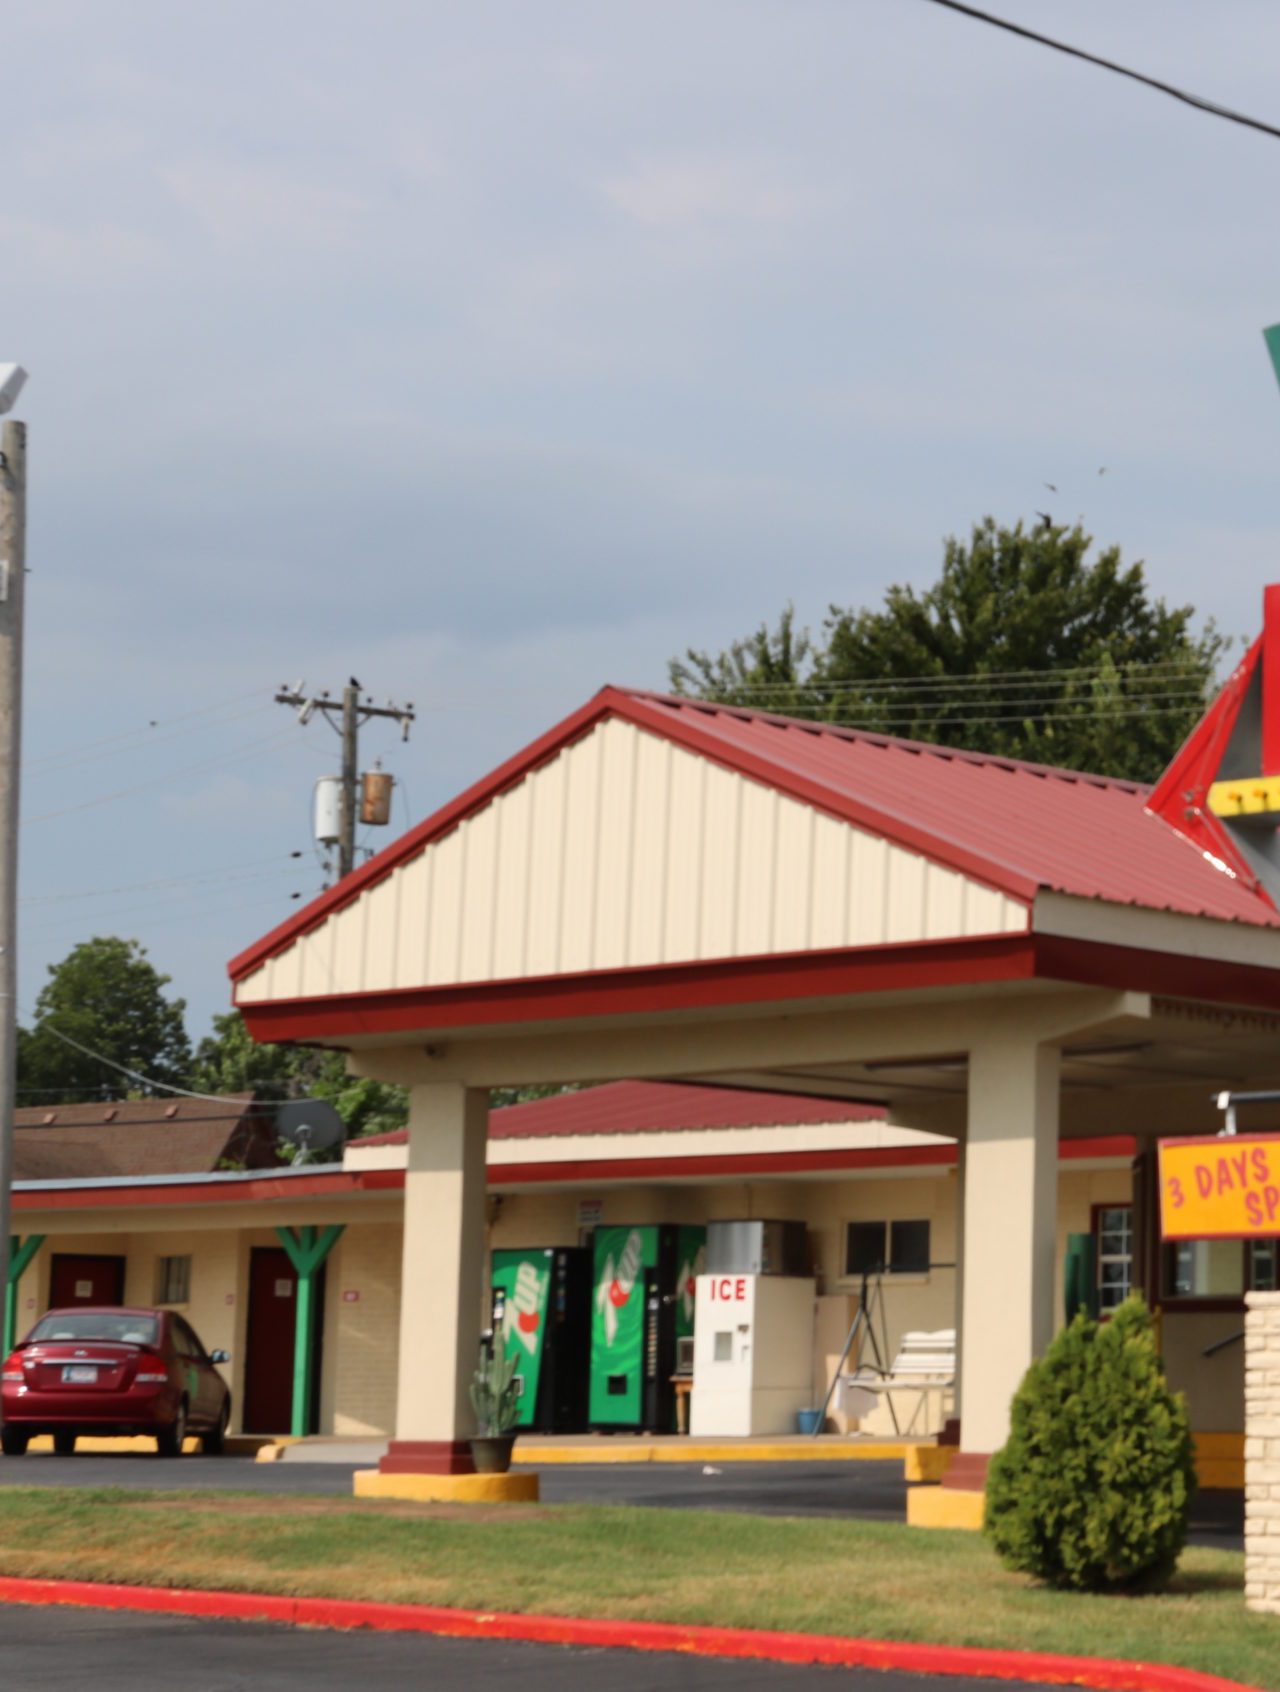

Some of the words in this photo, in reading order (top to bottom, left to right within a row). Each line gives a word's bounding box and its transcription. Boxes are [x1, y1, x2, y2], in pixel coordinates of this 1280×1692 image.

[1168, 1177, 1185, 1208] 3
[1194, 1147, 1269, 1199] DAYS
[710, 1278, 746, 1301] ICE
